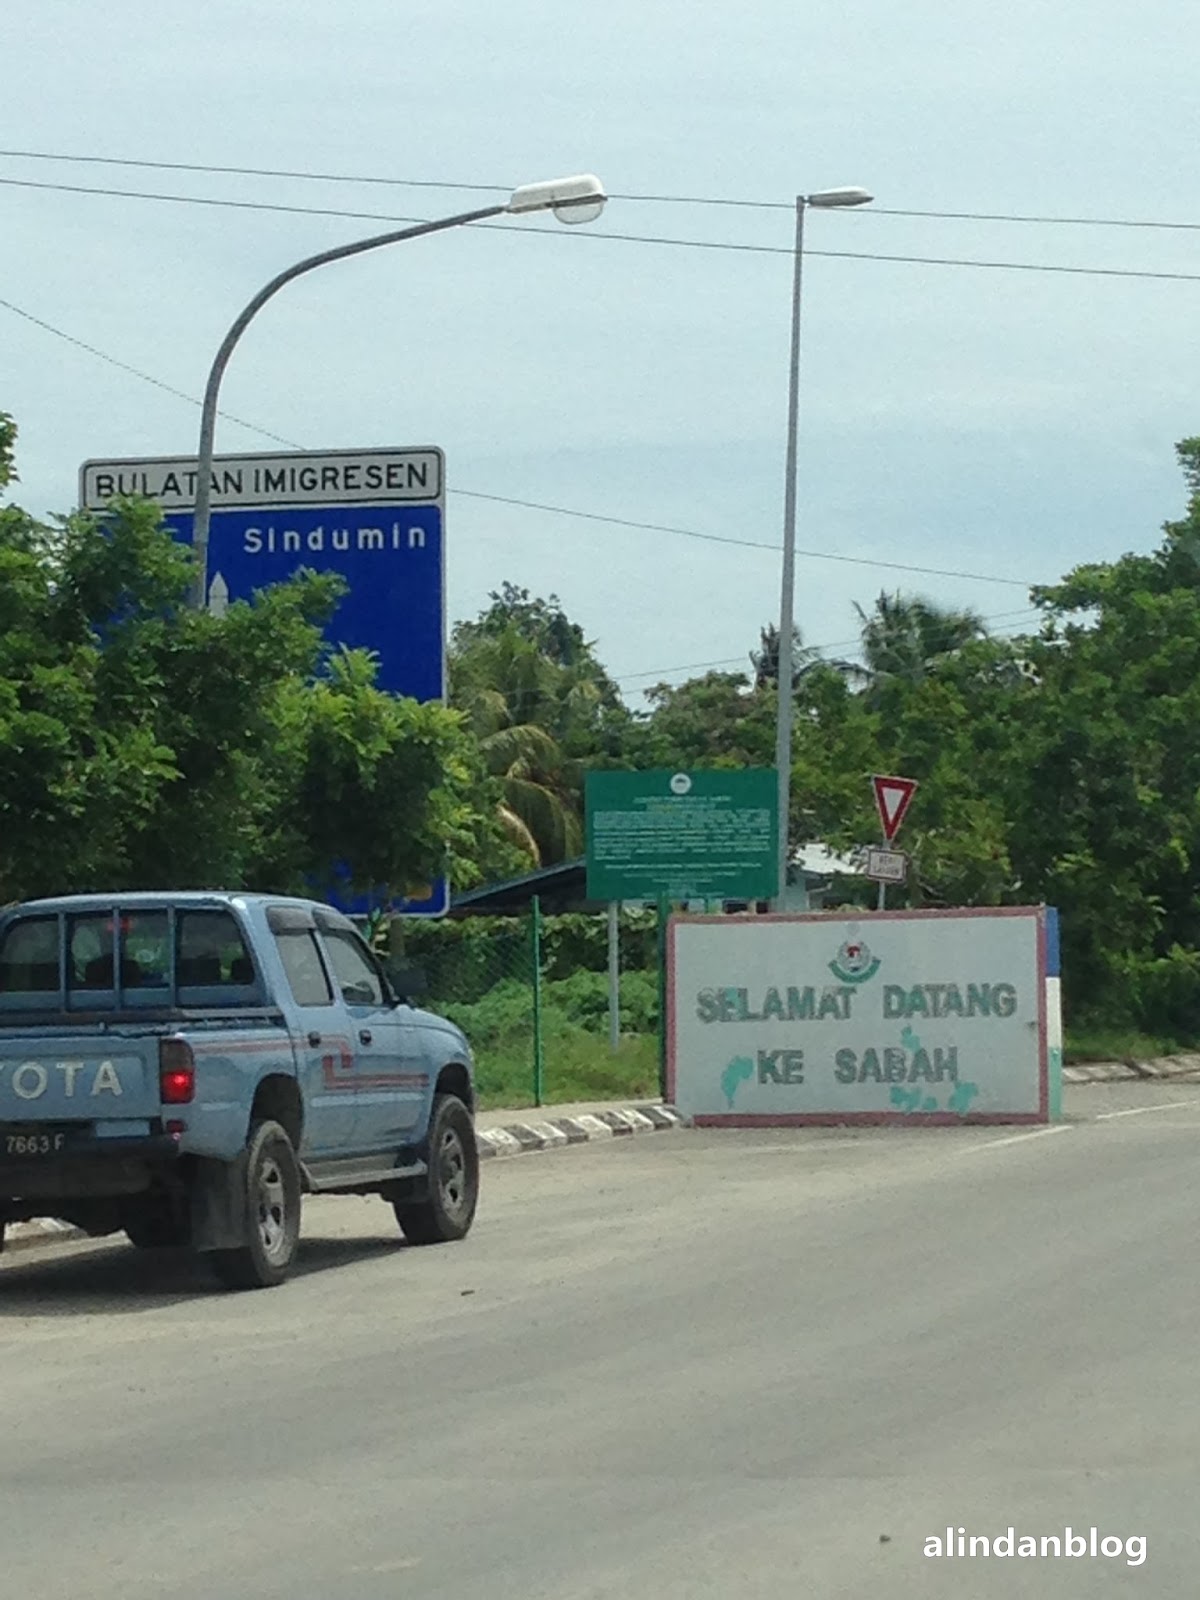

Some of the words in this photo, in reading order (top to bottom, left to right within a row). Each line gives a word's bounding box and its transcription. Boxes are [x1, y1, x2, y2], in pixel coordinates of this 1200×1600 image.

[95, 469, 243, 498] BULATAN
[254, 462, 428, 493] IMIGRESEN
[242, 522, 426, 554] Sindumin
[696, 984, 857, 1024] SELAMAT
[881, 981, 1018, 1019] DATANG
[0, 1060, 123, 1100] OTA
[756, 1049, 804, 1084] KE
[834, 1045, 959, 1084] SABAH
